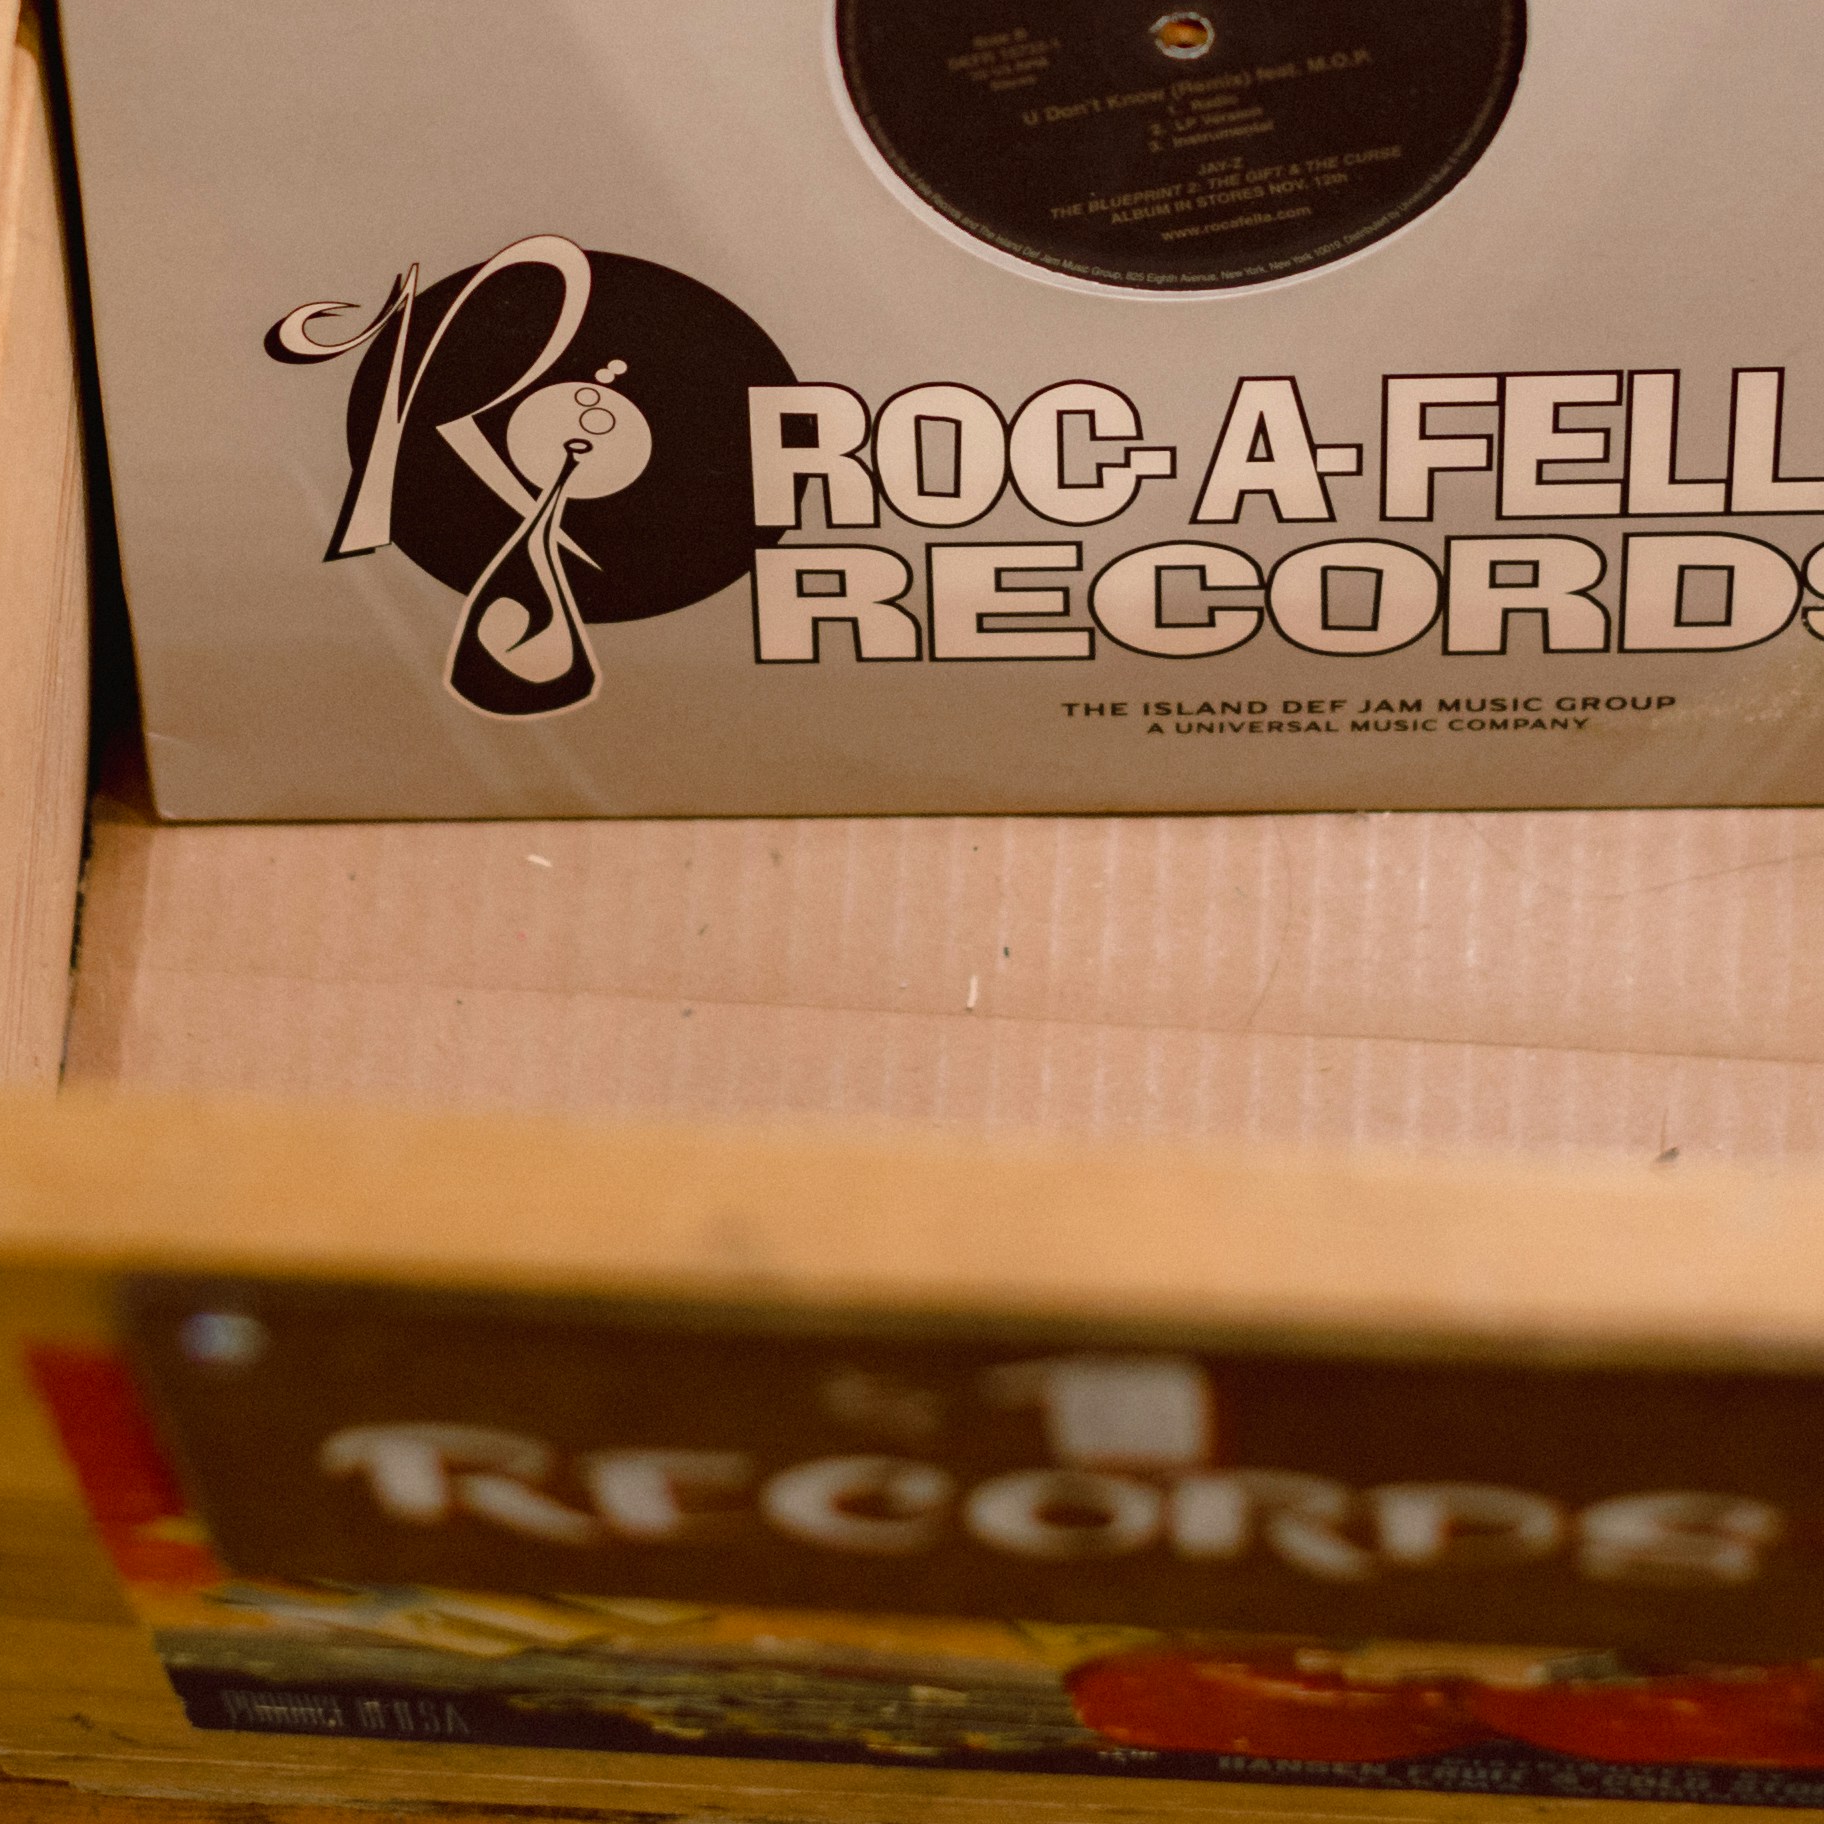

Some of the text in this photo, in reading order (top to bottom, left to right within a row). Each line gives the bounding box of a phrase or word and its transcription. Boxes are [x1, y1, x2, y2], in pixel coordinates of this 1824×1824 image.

[1043, 98, 1101, 124] Don't
[1106, 89, 1167, 111] Know
[1170, 71, 1253, 100] (Remix)
[1172, 119, 1275, 149] Instrumental
[1050, 203, 1084, 221] THE
[1087, 183, 1183, 214] BLUEPRINT
[1207, 173, 1242, 191] THE
[1245, 166, 1284, 185] GIFT
[1288, 162, 1302, 177] &
[1306, 157, 1340, 173] THE
[1342, 144, 1403, 168] CURSE
[1198, 156, 1243, 177] JAY-Z
[1110, 203, 1173, 226] ALBUM
[1175, 198, 1194, 214] IN
[1196, 185, 1266, 211] STORES
[1268, 177, 1309, 197] NOV.
[1161, 203, 1314, 242] www.rocafella.com
[1061, 258, 1090, 275] Music
[1220, 270, 1244, 280] New
[1268, 259, 1292, 272] New
[1060, 695, 1677, 717] THE ISLAND DEF JAM MUSIC GROUP
[1146, 717, 1591, 735] A UNIVERSAL MUSIC COMPANY
[316, 1416, 1786, 1584] RECORDS
